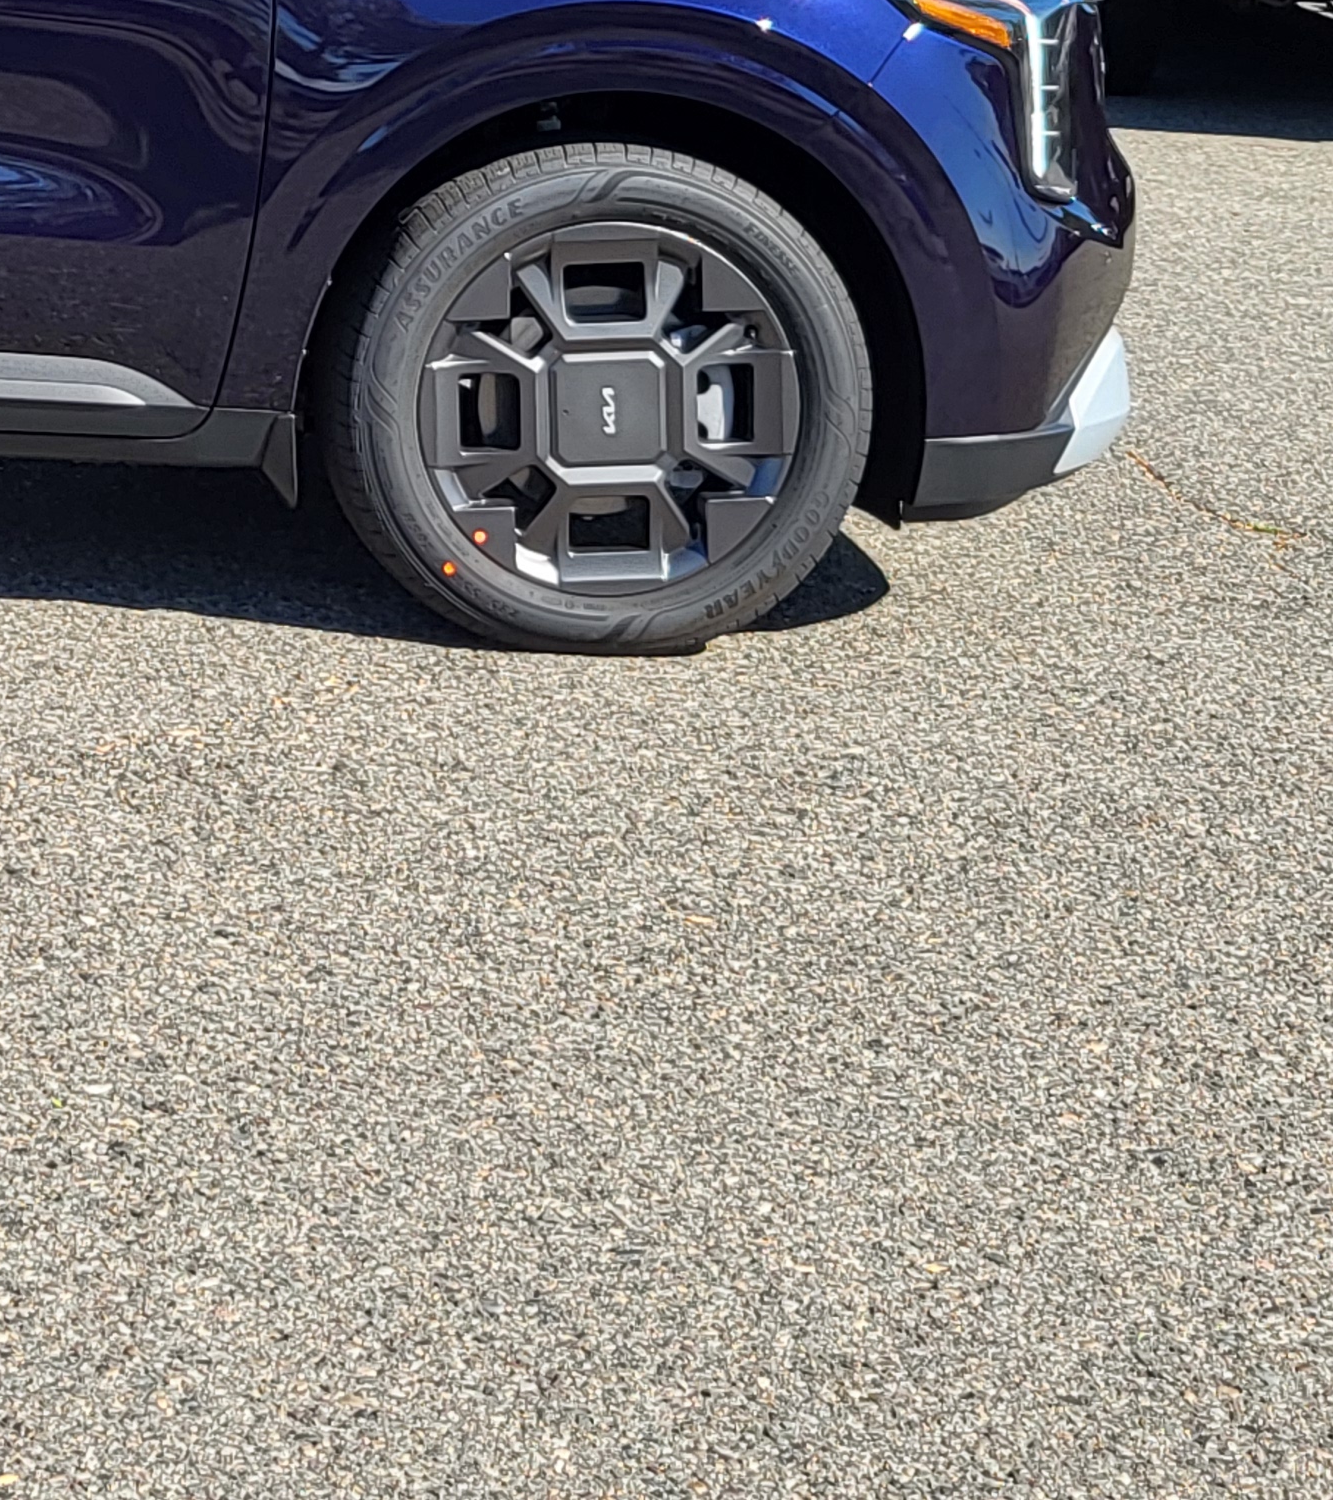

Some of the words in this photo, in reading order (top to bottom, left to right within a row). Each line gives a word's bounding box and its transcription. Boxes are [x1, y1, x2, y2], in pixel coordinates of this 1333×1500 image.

[393, 196, 525, 334] ASSURANCE
[601, 386, 617, 435] KIA
[702, 489, 831, 620] GOODYEAR
